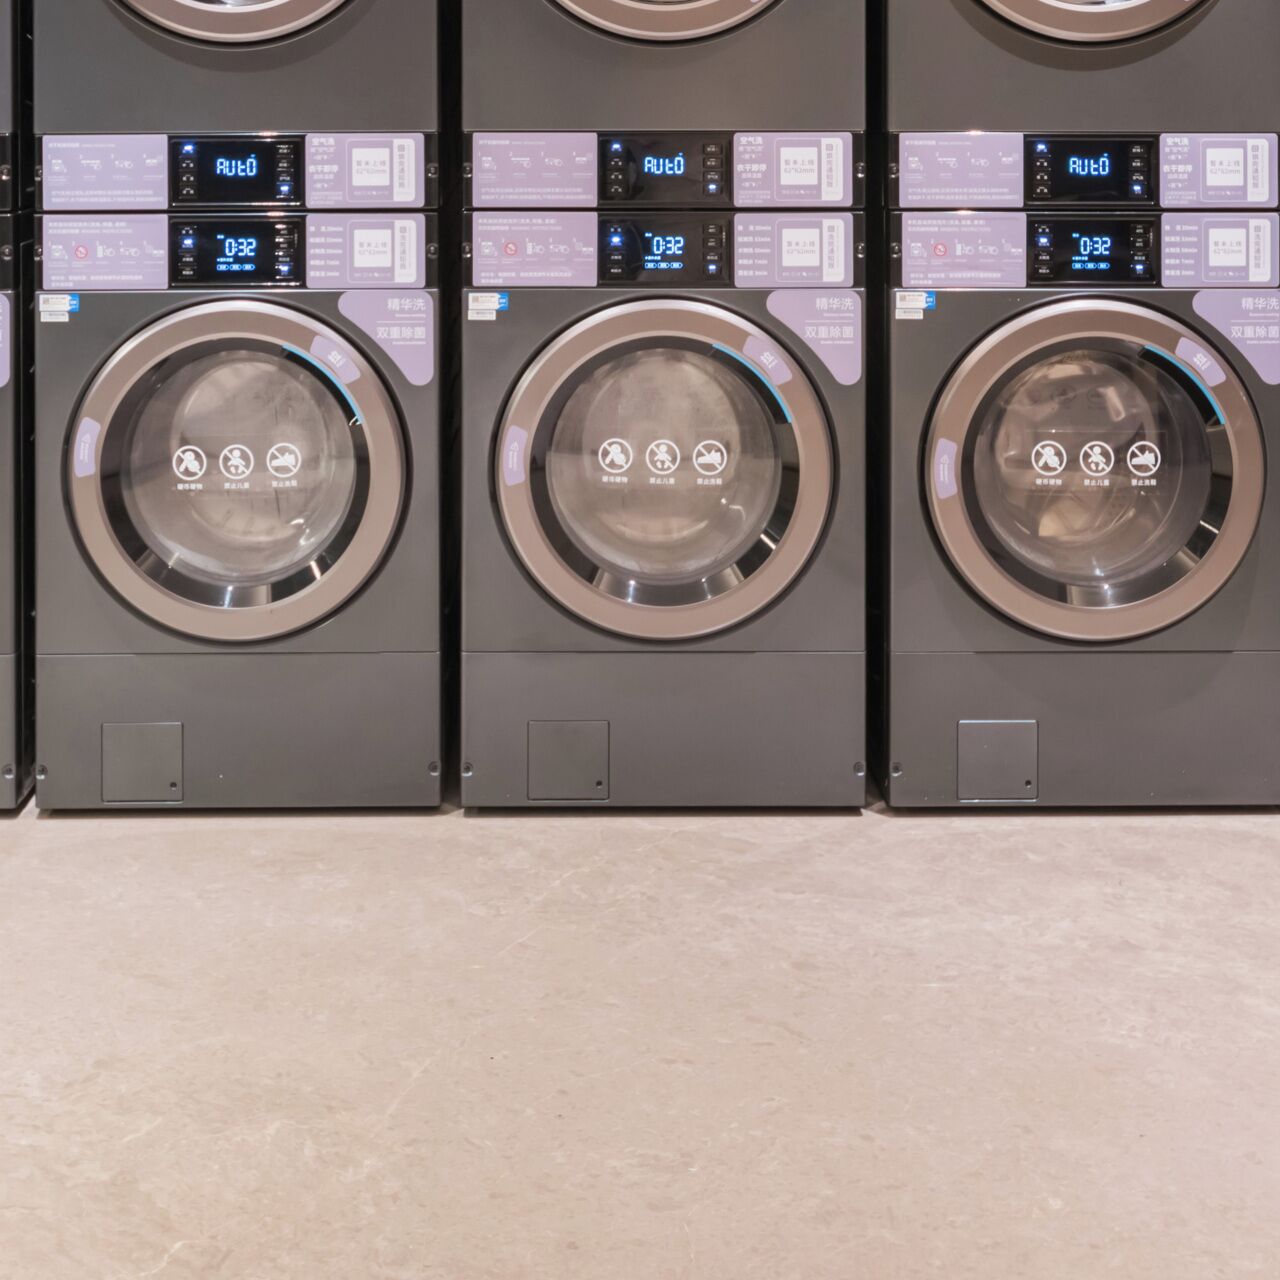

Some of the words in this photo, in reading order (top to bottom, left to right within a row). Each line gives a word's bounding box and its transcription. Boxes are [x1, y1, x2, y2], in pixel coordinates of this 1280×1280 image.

[224, 238, 256, 256] 0:32
[652, 237, 684, 255] 0:32
[1080, 237, 1111, 255] 0:32
[387, 298, 426, 310] 精华洗
[816, 297, 854, 310] 精华洗
[1241, 297, 1279, 310] 精华洗
[376, 327, 426, 339] 双重除菌
[805, 326, 854, 338] 双重除菌
[1231, 326, 1279, 338] 双重除菌
